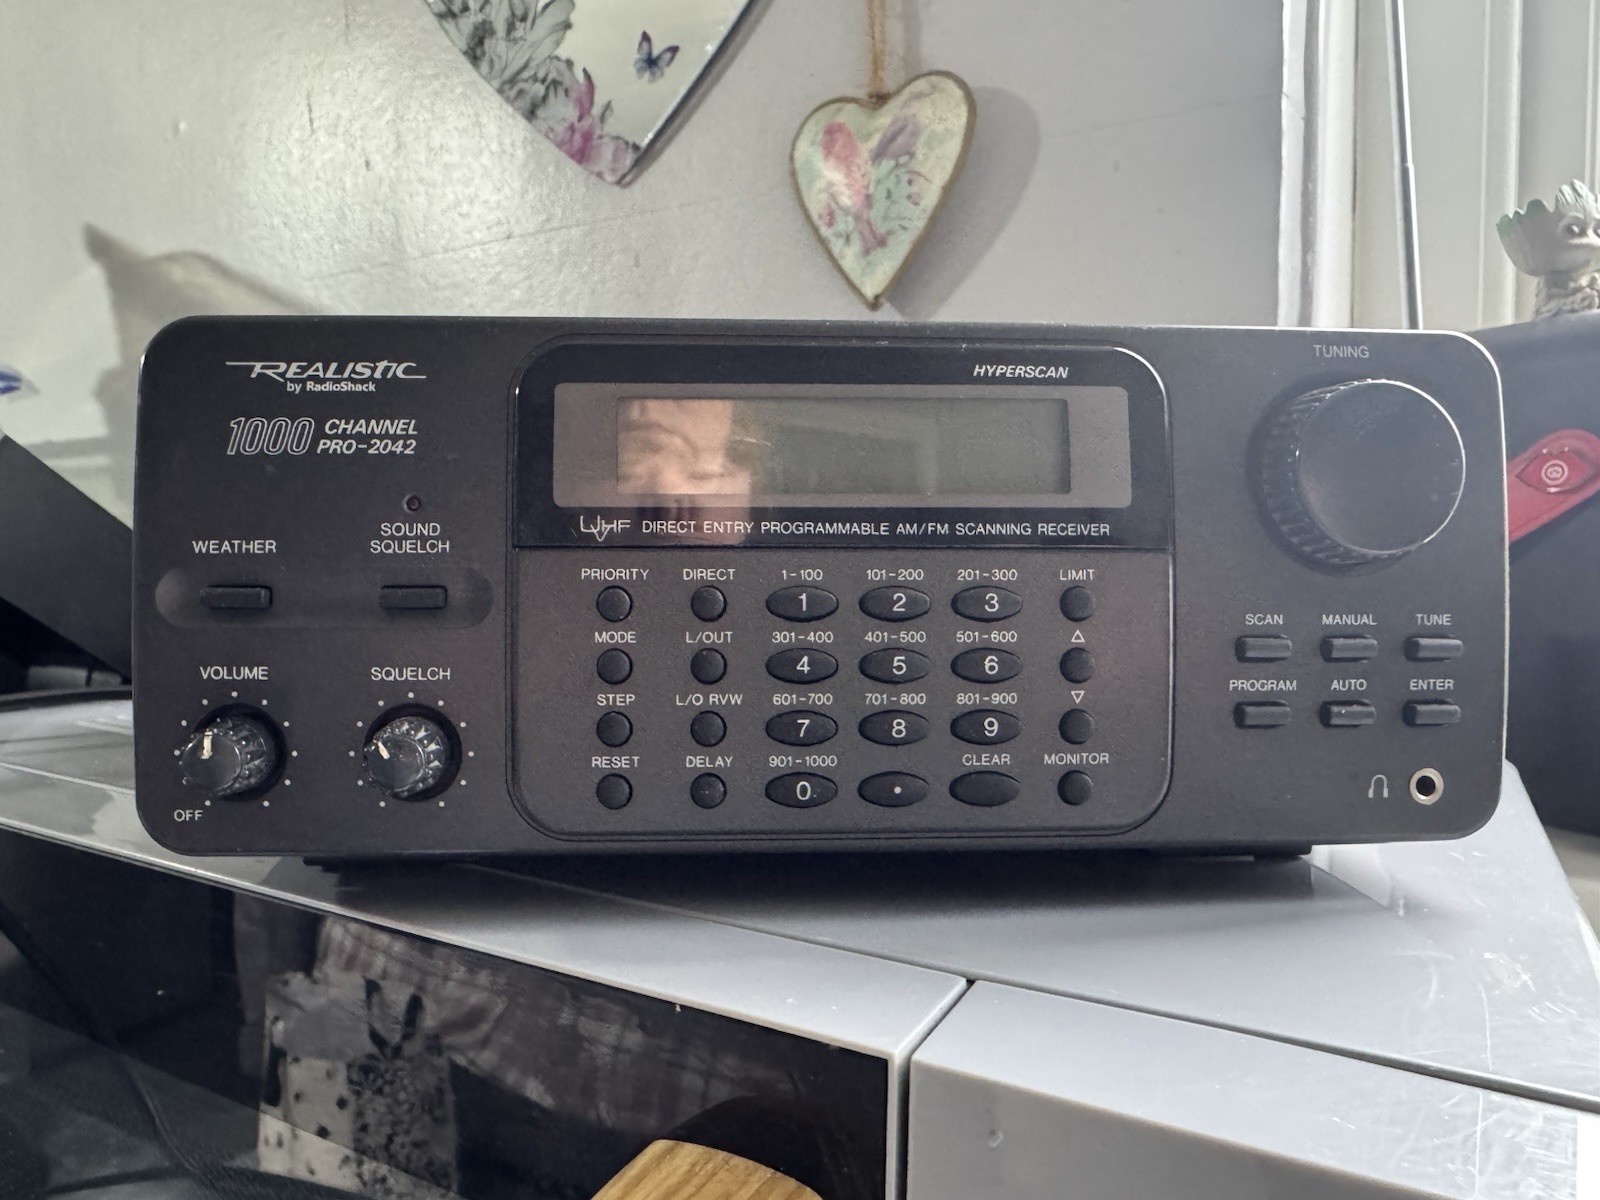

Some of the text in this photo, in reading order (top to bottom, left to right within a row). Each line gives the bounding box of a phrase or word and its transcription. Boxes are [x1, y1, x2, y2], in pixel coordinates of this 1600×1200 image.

[1313, 344, 1370, 360] TUNING
[973, 364, 1069, 379] HYPERSCAN
[287, 380, 376, 394] by RadioShack
[324, 419, 418, 435] CHANNEL
[227, 417, 315, 455] 1000
[316, 439, 417, 455] PRO-2042
[380, 522, 441, 537] SOUND
[642, 520, 1110, 536] DIRECT ENTRY PROGRAMMABLE AM/FM SCANNING RECEIVER
[192, 539, 277, 554] WEATHER
[370, 539, 450, 554] SQUELCH
[581, 568, 650, 581] PRIORITY
[682, 568, 736, 581] DIRECT
[781, 569, 824, 581] 1-100
[866, 569, 924, 581] 101-200
[957, 569, 1018, 581] 201-300
[1059, 569, 1095, 581] LIMIT
[798, 592, 807, 612] 1
[892, 592, 906, 612] 2
[984, 592, 999, 612] 3
[1245, 613, 1283, 626] SCAN
[1322, 613, 1377, 627] MANUAL
[1415, 613, 1452, 626] TUNE
[594, 631, 637, 644] MODE
[685, 631, 733, 644] L/OUT
[772, 631, 834, 643] 301-400
[864, 631, 927, 643] 401-500
[956, 631, 1018, 643] 501-600
[796, 655, 810, 674] 4
[892, 656, 907, 675] 5
[984, 655, 999, 674] 6
[200, 666, 269, 681] VOLUME
[371, 667, 451, 682] SQUELCH
[1229, 678, 1297, 692] PROGRAM
[1330, 678, 1367, 692] AUTO
[1409, 678, 1454, 691] ENTER
[596, 693, 635, 706] STEP
[676, 693, 743, 706] L/O RVW
[772, 693, 833, 705] 601-700
[865, 693, 927, 705] 701-800
[956, 693, 1018, 705] 801-900
[796, 719, 810, 738] 7
[891, 718, 907, 738] 8
[983, 717, 999, 737] 9
[591, 755, 640, 768] RESET
[685, 755, 733, 768] DELAY
[768, 755, 838, 767] 901-1000
[962, 754, 1011, 766] CLEAR
[1043, 752, 1109, 766] MONITOR
[796, 781, 811, 800] 0
[173, 809, 203, 823] OFF
